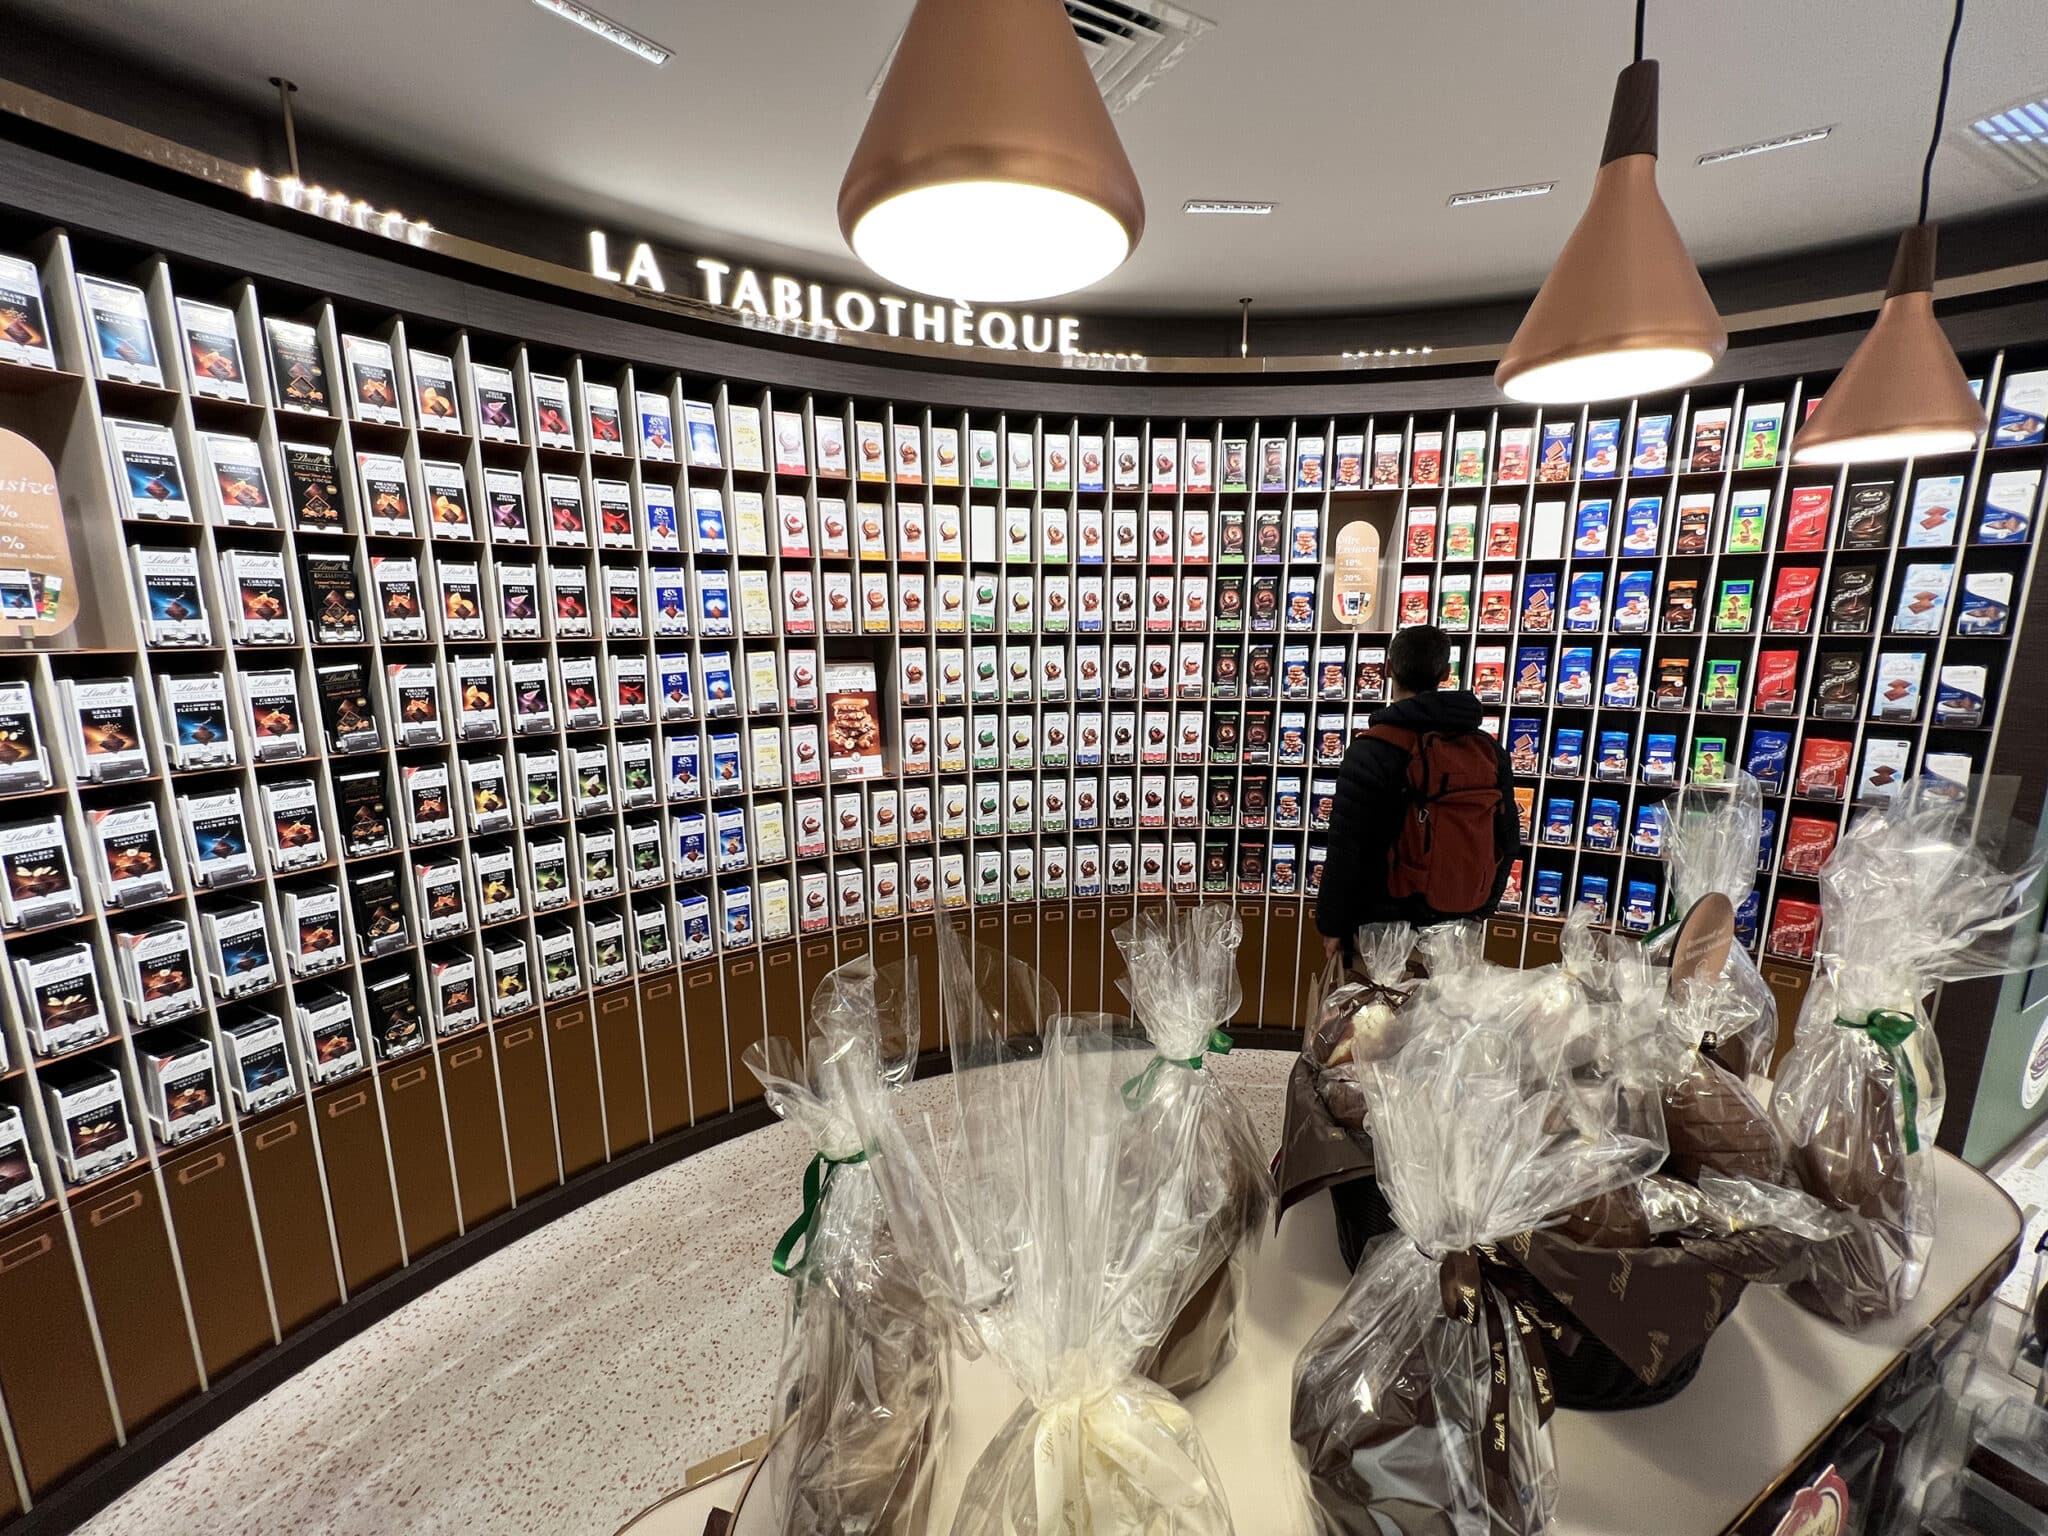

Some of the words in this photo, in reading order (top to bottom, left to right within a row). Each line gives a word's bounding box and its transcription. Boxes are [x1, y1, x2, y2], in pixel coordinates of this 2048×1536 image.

[590, 230, 665, 292] LA
[696, 259, 1080, 355] TABLOTHÈQUE
[82, 688, 116, 697] Lindt
[3, 829, 43, 842] Lindt
[106, 816, 139, 826] Lindt
[1513, 1228, 1534, 1260] Lin
[1609, 1249, 1633, 1301] Lindt
[1494, 1351, 1506, 1385] Lindt
[1533, 1367, 1549, 1397] Lindt
[1494, 1419, 1505, 1452] Lindt
